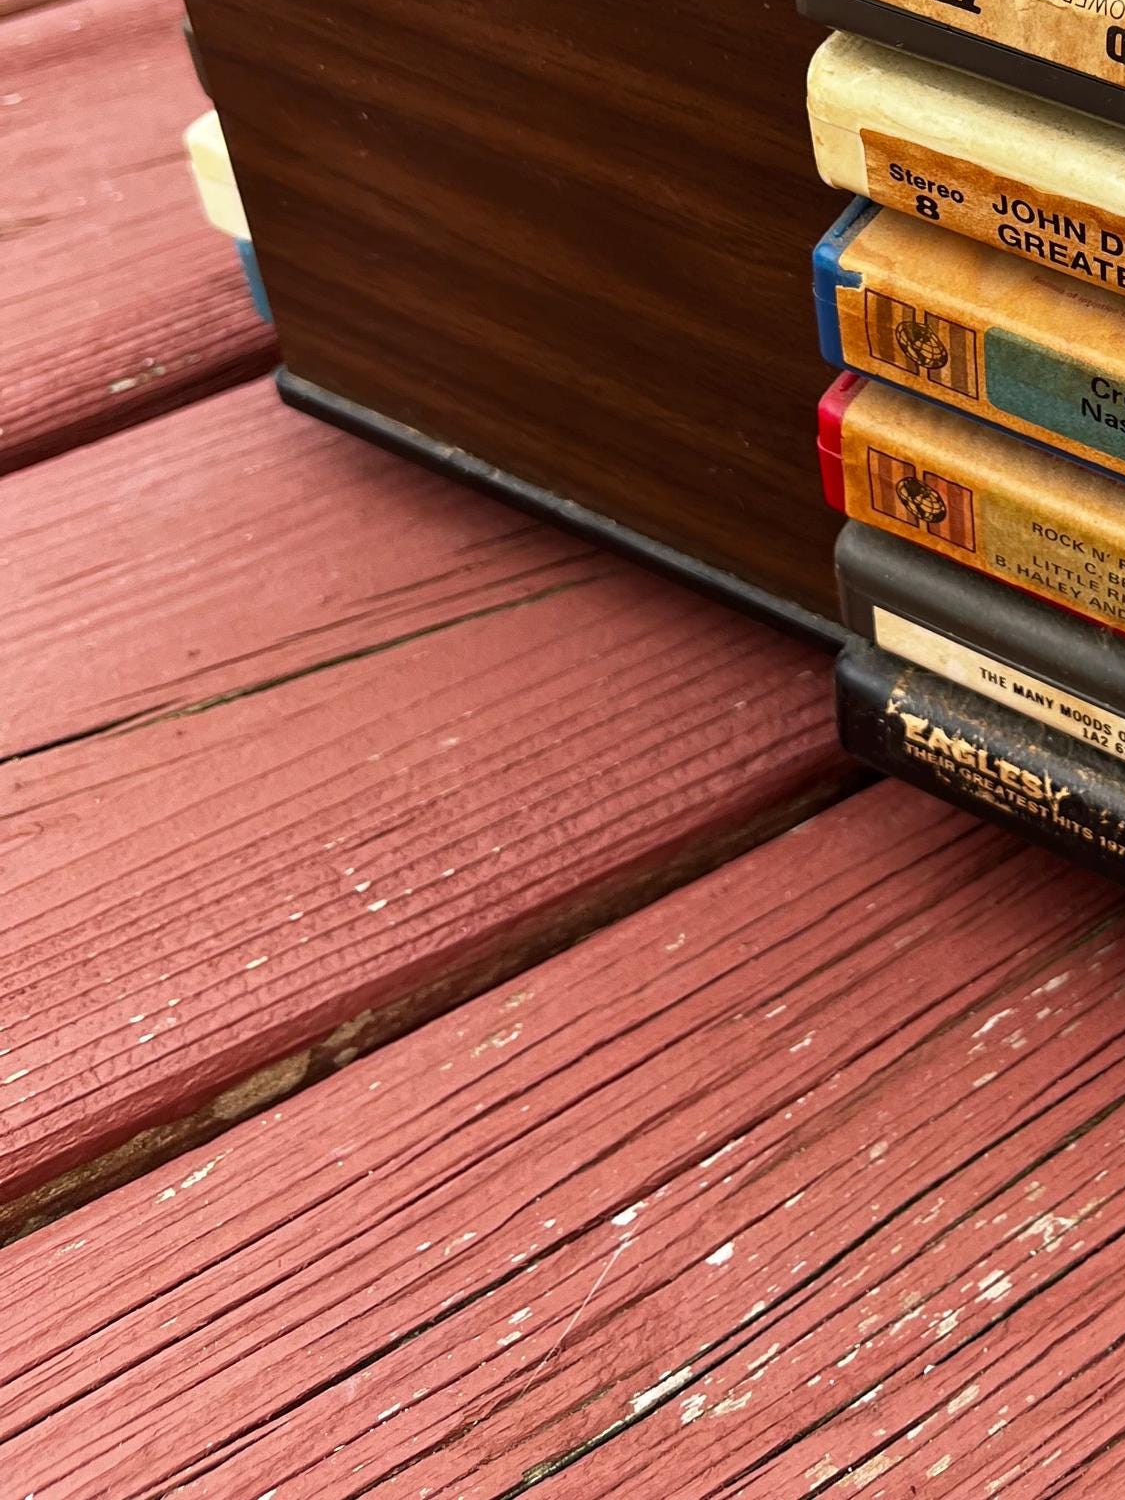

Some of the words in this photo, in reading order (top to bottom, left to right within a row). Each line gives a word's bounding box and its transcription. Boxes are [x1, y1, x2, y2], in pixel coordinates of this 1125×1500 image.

[888, 162, 965, 204] Stereo
[914, 193, 941, 221] 8
[991, 193, 1088, 246] JOHN
[1031, 521, 1086, 554] ROCK
[1091, 547, 1111, 564] N'
[994, 553, 1012, 572] B.
[1016, 563, 1082, 599] HALEY
[1031, 554, 1100, 592] LITTLE
[1084, 561, 1103, 579] C.
[979, 666, 1008, 689] THE
[1012, 682, 1055, 711] MANY
[1059, 703, 1114, 737] MOODS
[899, 711, 1046, 800] EAGLES
[1081, 726, 1110, 749] 1A2
[903, 740, 957, 773] THEIR
[958, 766, 1051, 819] GREATEST
[1052, 813, 1094, 841] HITS
